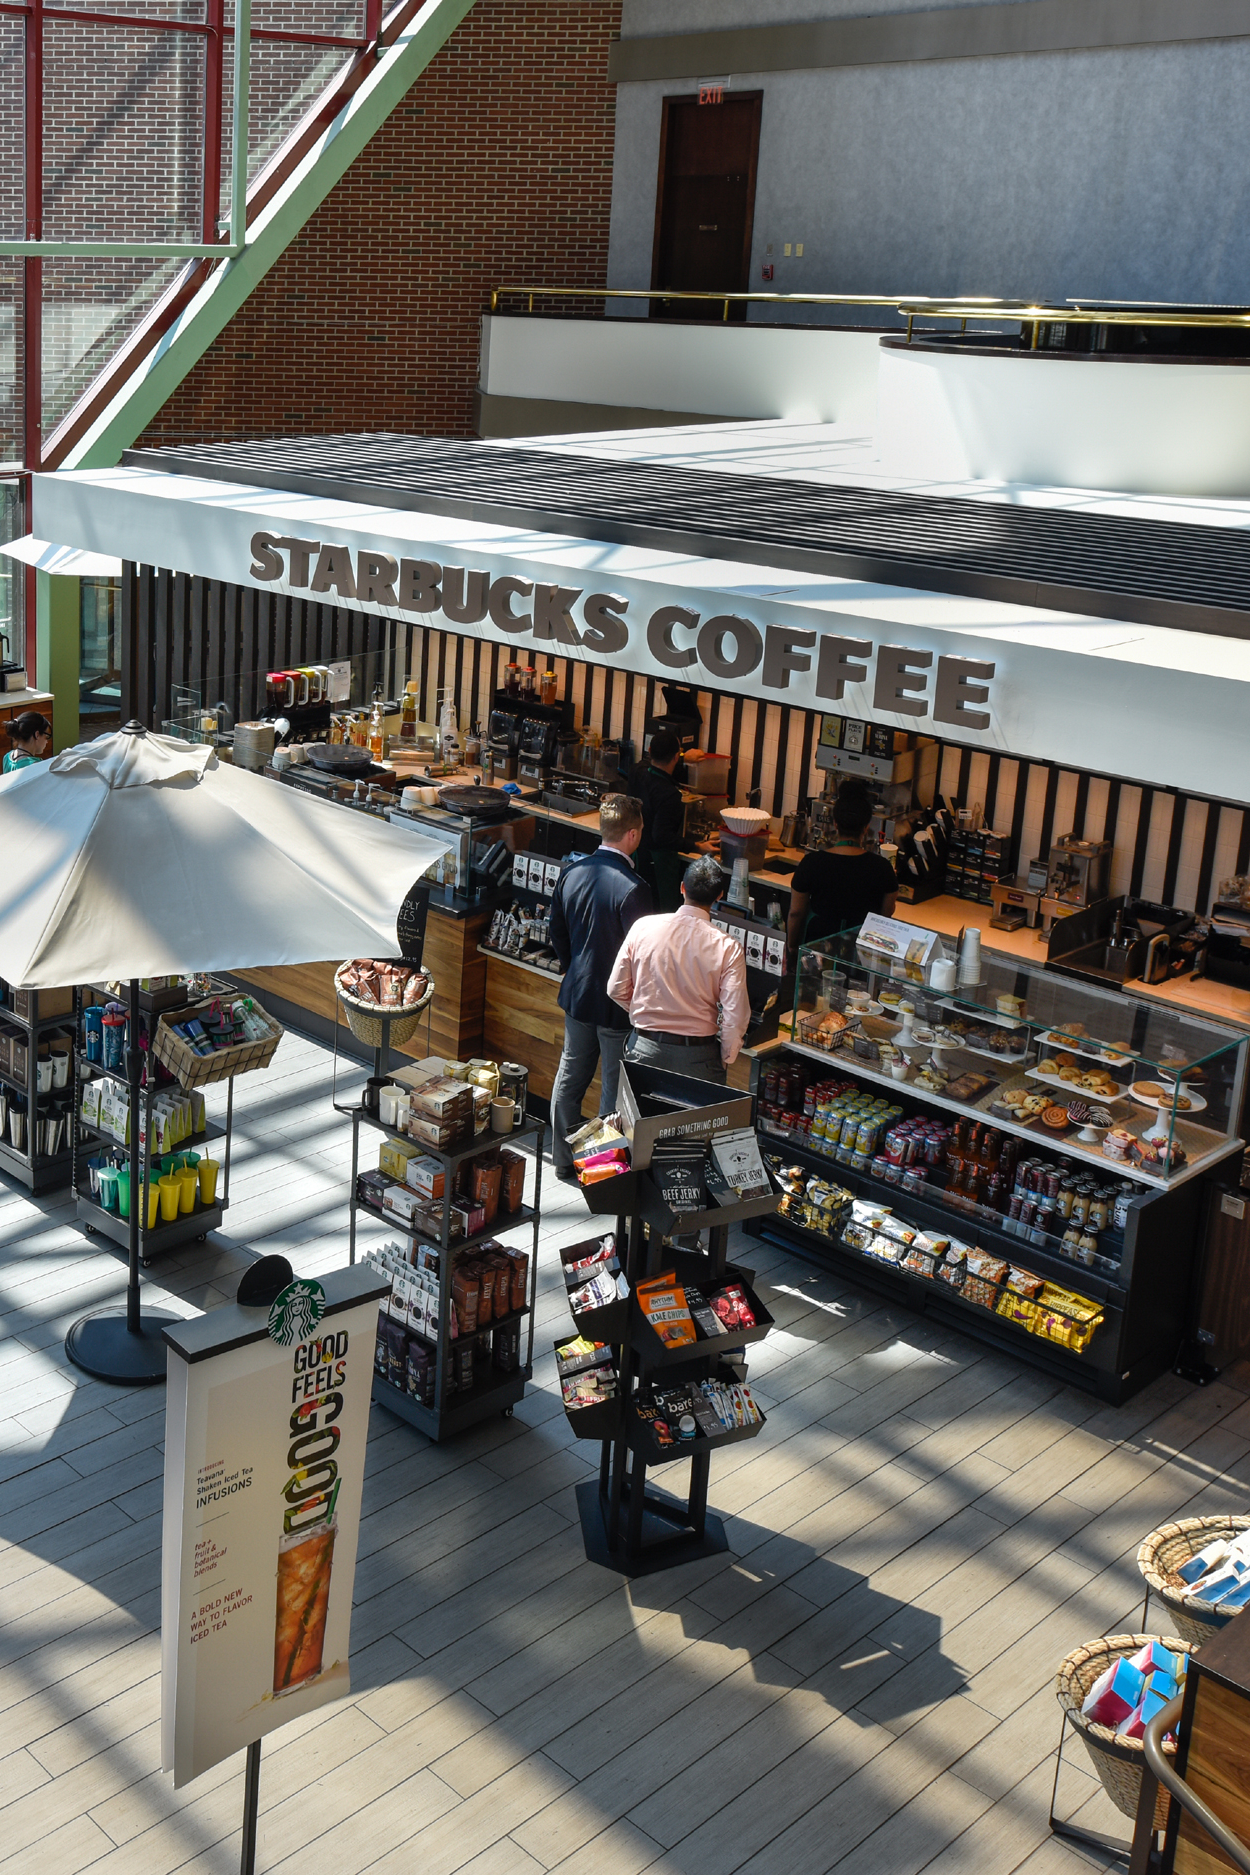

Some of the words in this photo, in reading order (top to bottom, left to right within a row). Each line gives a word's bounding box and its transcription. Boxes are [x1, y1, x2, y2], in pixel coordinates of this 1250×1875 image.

[700, 86, 723, 104] EXIT
[250, 530, 629, 653] STARBUCKS
[646, 605, 996, 731] COFFEE
[659, 1127, 676, 1139] GRAB
[676, 1119, 712, 1136] SOMETHING
[712, 1116, 729, 1129] GOOD
[727, 1171, 748, 1186] TURKEY
[748, 1169, 763, 1181] JERKY
[662, 1188, 679, 1201] BEEF
[679, 1187, 701, 1201] JERKY
[651, 1312, 666, 1323] KALE
[667, 1309, 686, 1320] CHIPS
[1049, 1300, 1078, 1317] HIPPEAS
[294, 1330, 349, 1375] GOOD
[292, 1360, 347, 1404] FEELS
[668, 1398, 693, 1413] bare
[198, 1460, 225, 1475] INTRODUCING
[282, 1391, 344, 1535] GOOD
[196, 1469, 225, 1485] Teavana
[197, 1480, 222, 1496] Shaken
[224, 1471, 239, 1484] Iced
[242, 1467, 254, 1476] Tea
[196, 1476, 252, 1509] INFUSIONS
[195, 1541, 206, 1551] tea
[195, 1547, 210, 1560] fruit
[211, 1543, 217, 1552] &
[194, 1547, 227, 1569] botanical
[194, 1562, 218, 1578] blends
[191, 1611, 197, 1620] A
[200, 1599, 222, 1616] BOLD
[224, 1588, 243, 1604] NEW
[191, 1617, 208, 1632] WAY
[210, 1611, 220, 1622] TO
[223, 1595, 253, 1616] FLAVOR
[190, 1628, 210, 1644] ICED
[211, 1619, 227, 1632] TEA
